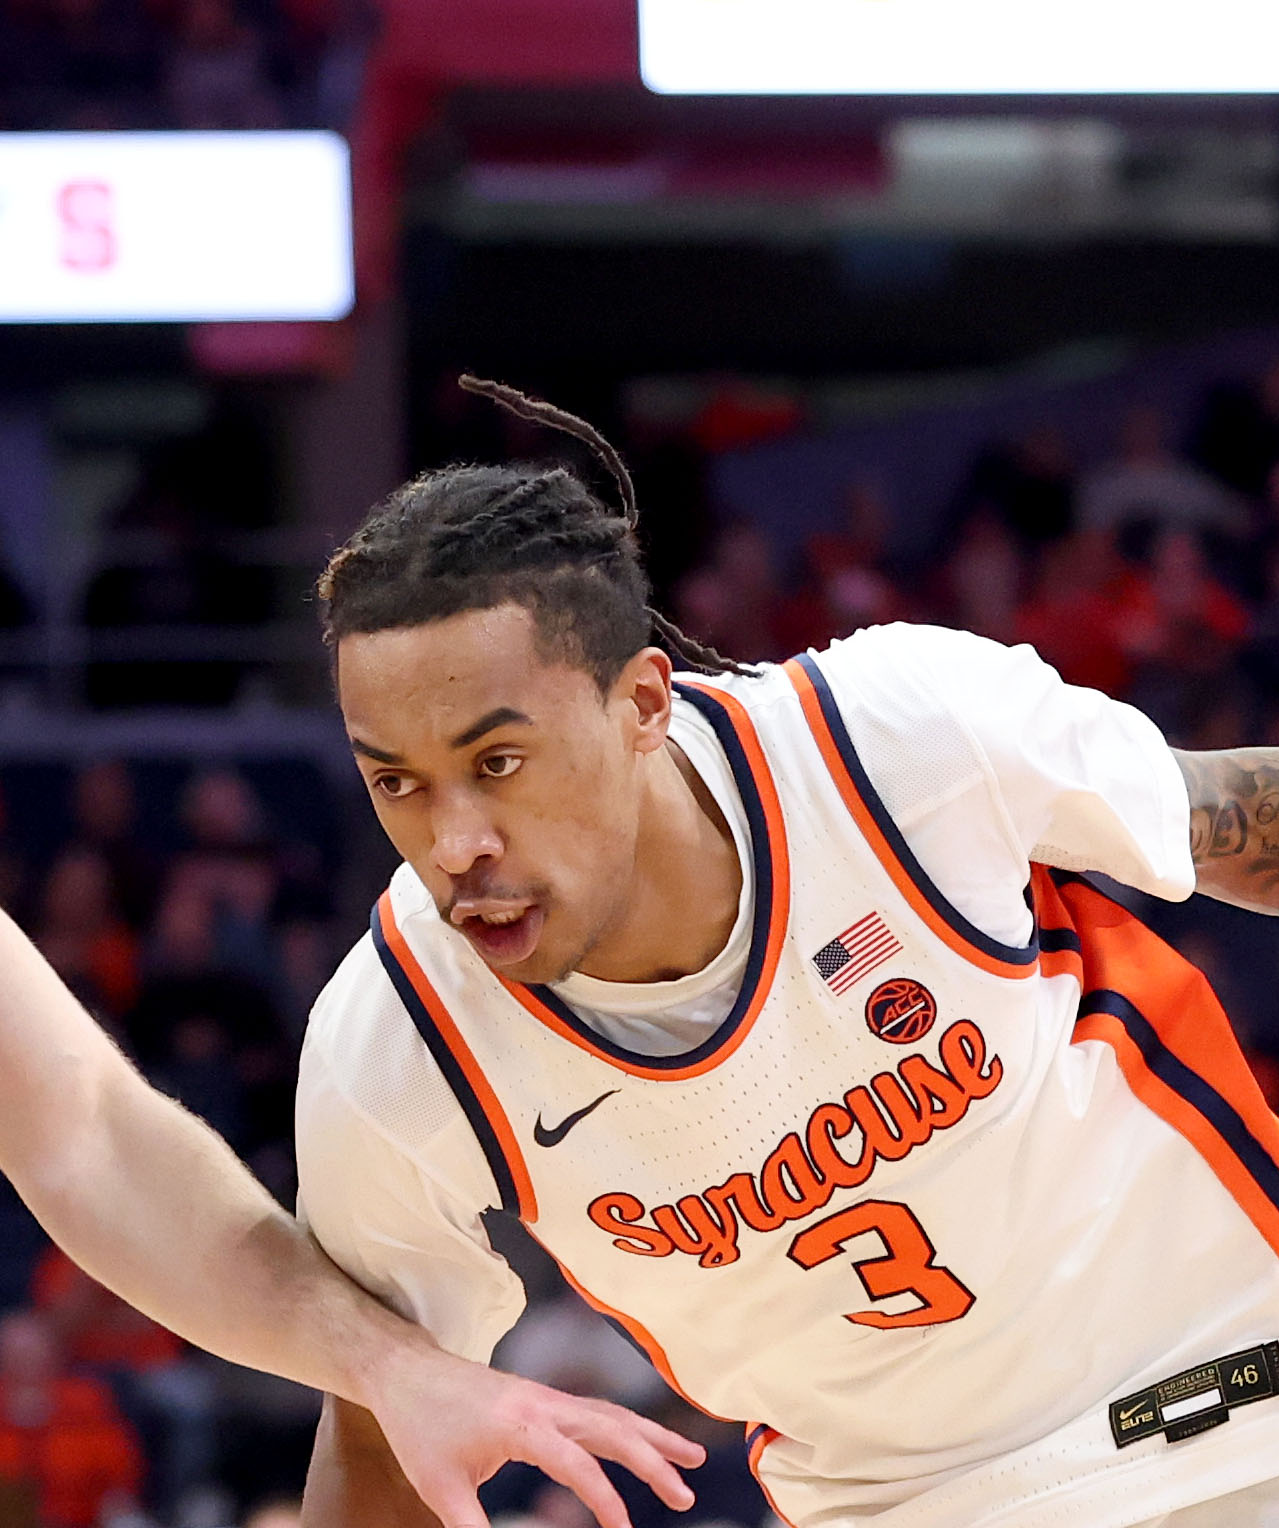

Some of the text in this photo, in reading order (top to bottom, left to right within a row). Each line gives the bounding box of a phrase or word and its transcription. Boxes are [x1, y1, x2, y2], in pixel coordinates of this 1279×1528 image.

[56, 179, 117, 271] S
[882, 987, 924, 1026] ACC
[587, 1018, 1004, 1268] Syracuse
[786, 1199, 977, 1330] 3
[1230, 1364, 1260, 1388] 46
[1121, 1410, 1154, 1431] ELITE
